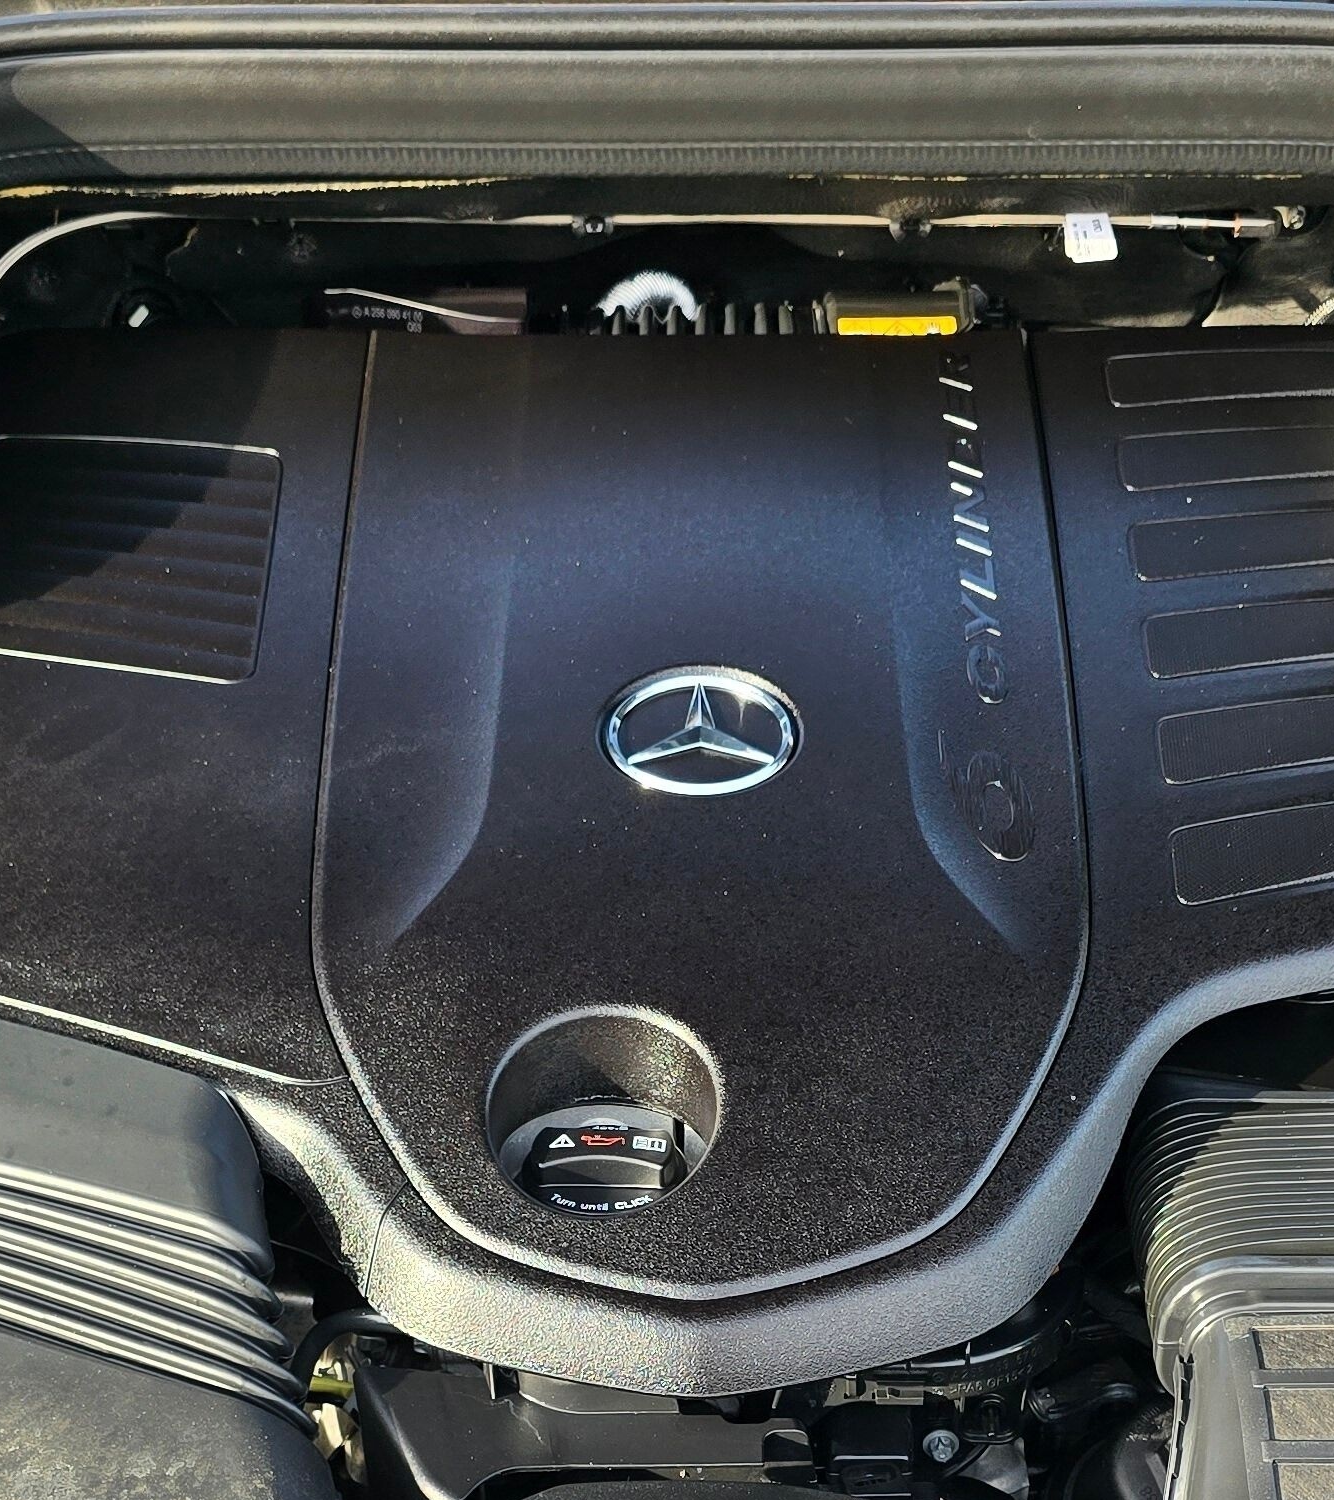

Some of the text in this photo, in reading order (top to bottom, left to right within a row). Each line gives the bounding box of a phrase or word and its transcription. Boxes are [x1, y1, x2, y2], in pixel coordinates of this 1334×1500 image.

[938, 350, 1009, 703] CYLINDER
[550, 1193, 654, 1211] Turn until CLICK
